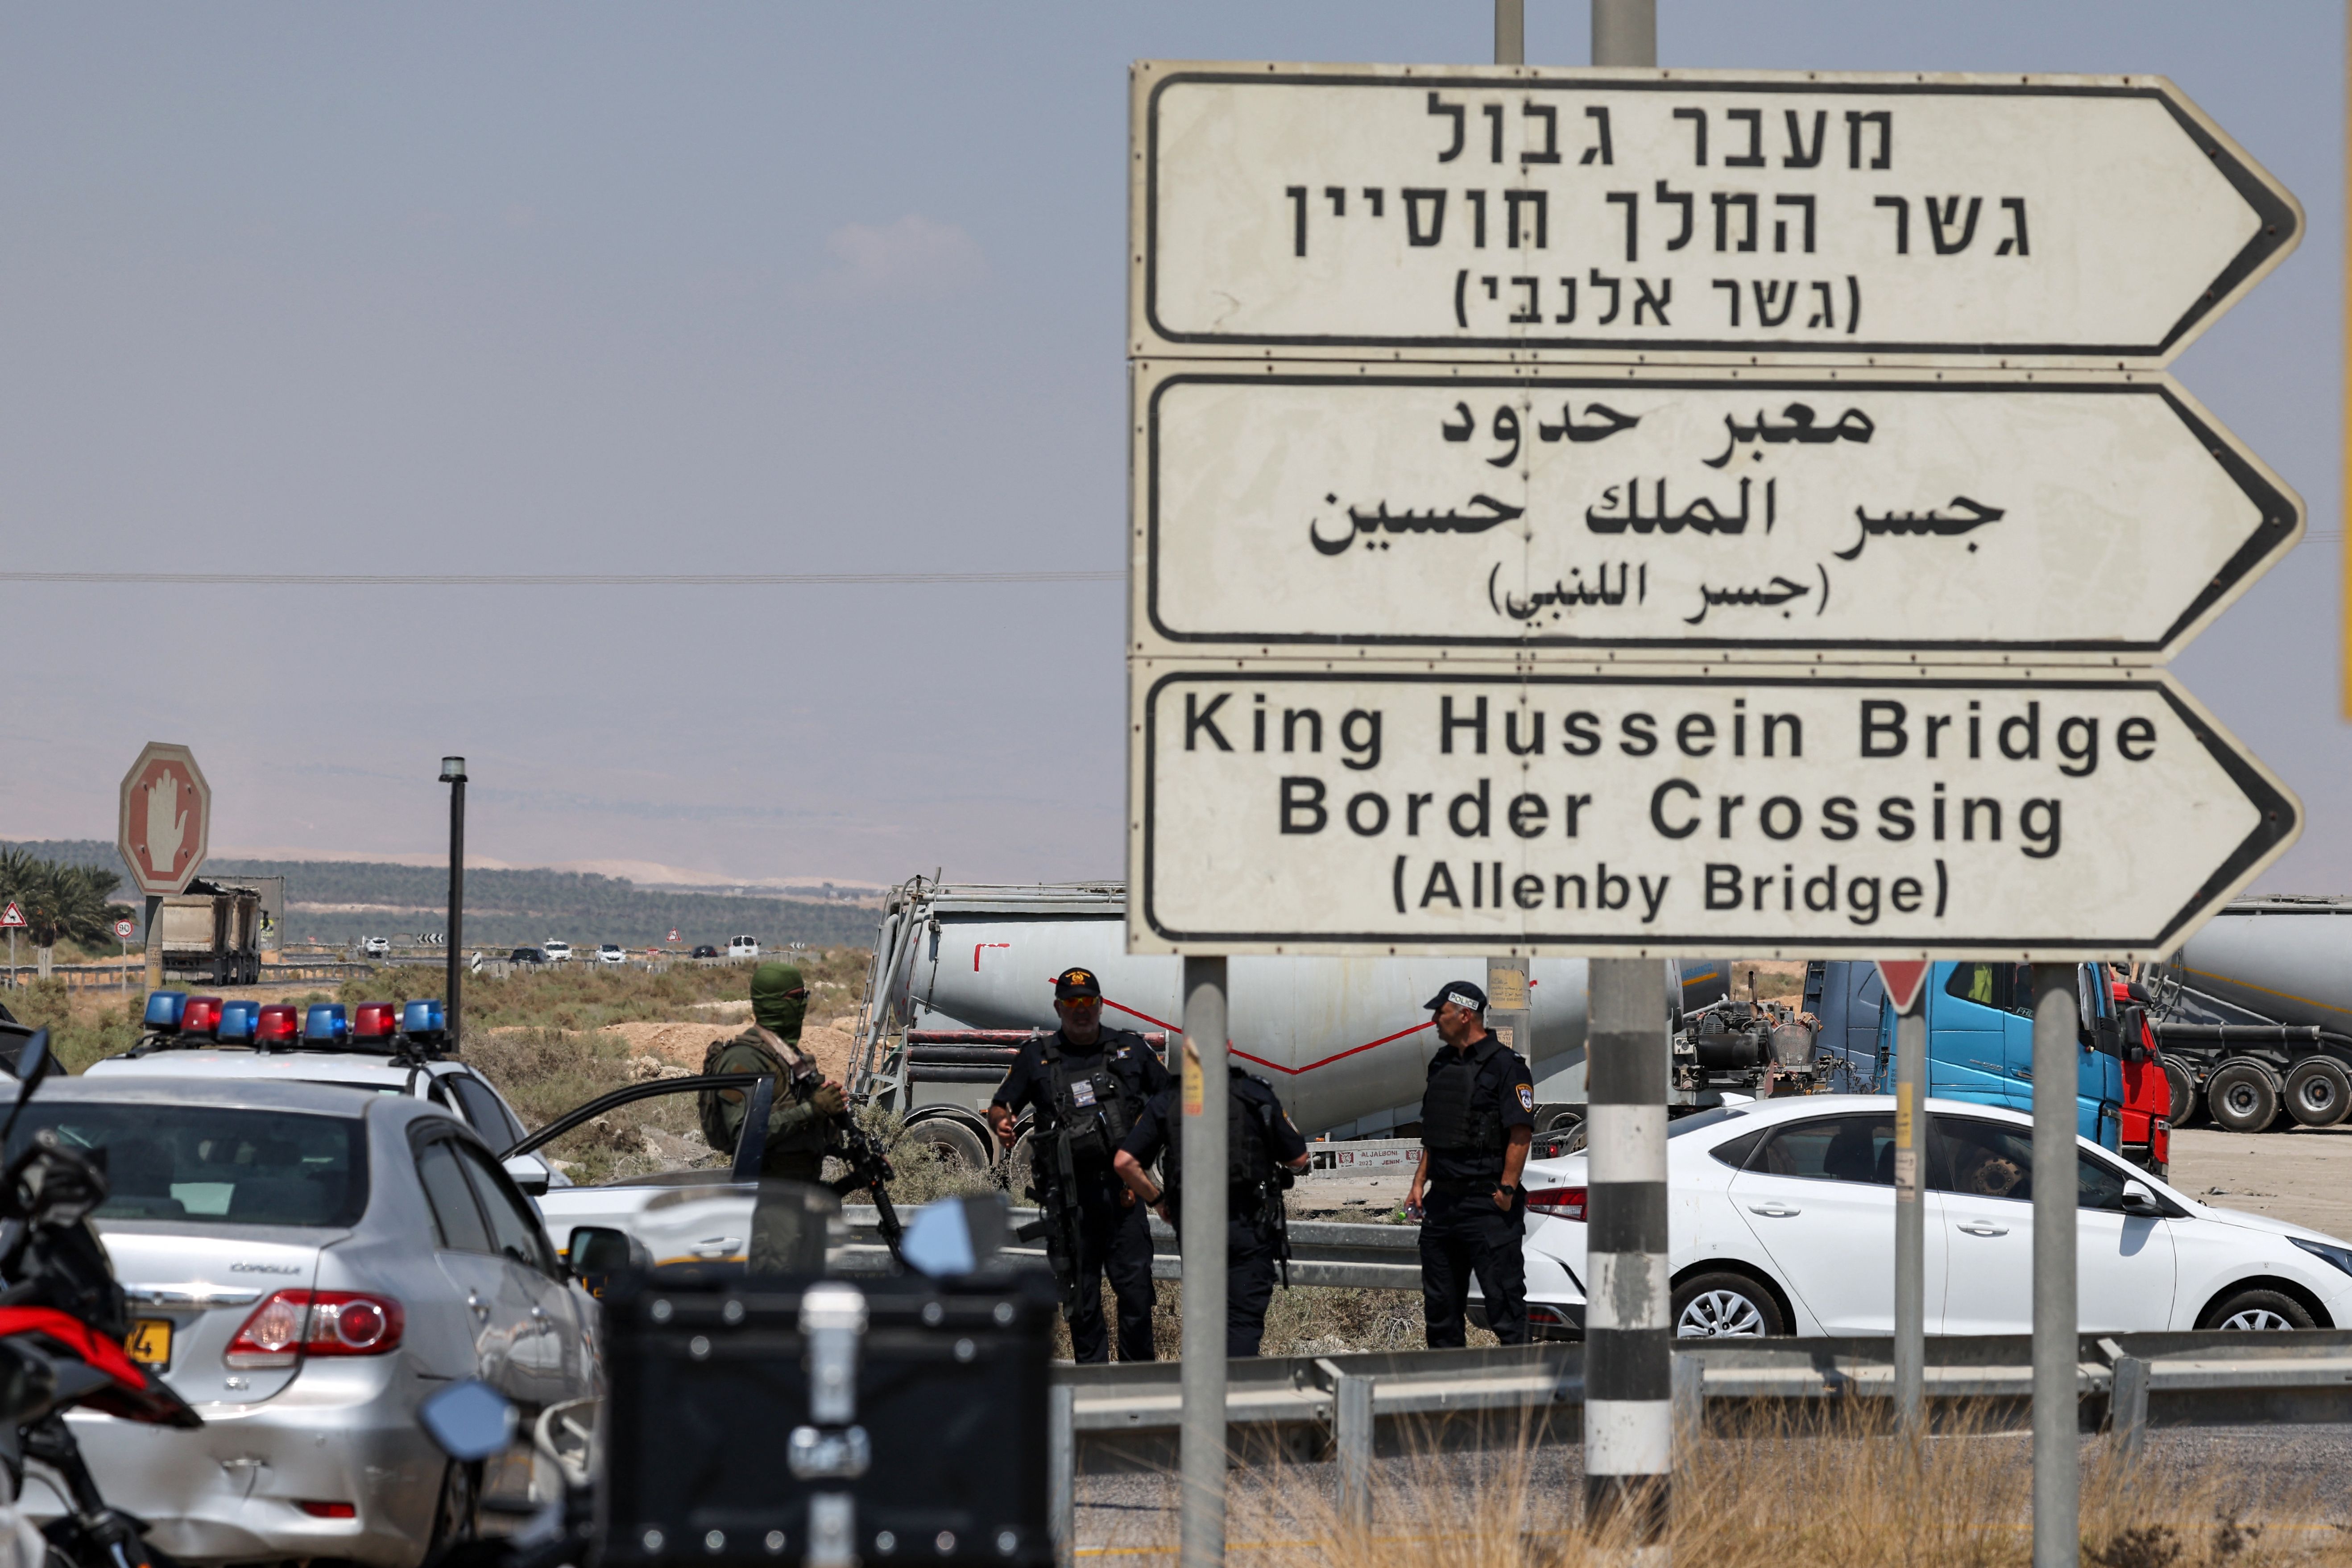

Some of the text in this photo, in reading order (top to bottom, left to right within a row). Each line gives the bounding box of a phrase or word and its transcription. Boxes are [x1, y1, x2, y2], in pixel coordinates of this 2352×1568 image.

[1428, 92, 1891, 169] מעבר גבול
[1287, 180, 2029, 261] גשר המלך חוסיין
[1455, 269, 1859, 333] (גשר אלנבי)
[1443, 402, 1874, 468] معبر حدود
[1311, 477, 2004, 560] جسر الملك حسين
[1489, 562, 1828, 627] (جسر اللنبي)
[1185, 693, 2156, 777] King Hussein Bridge
[1281, 776, 2060, 859] Border Crossing
[1394, 855, 1947, 923] (Allenby Bridge)
[119, 924, 129, 932] 90
[1451, 994, 1477, 1008] POLICE
